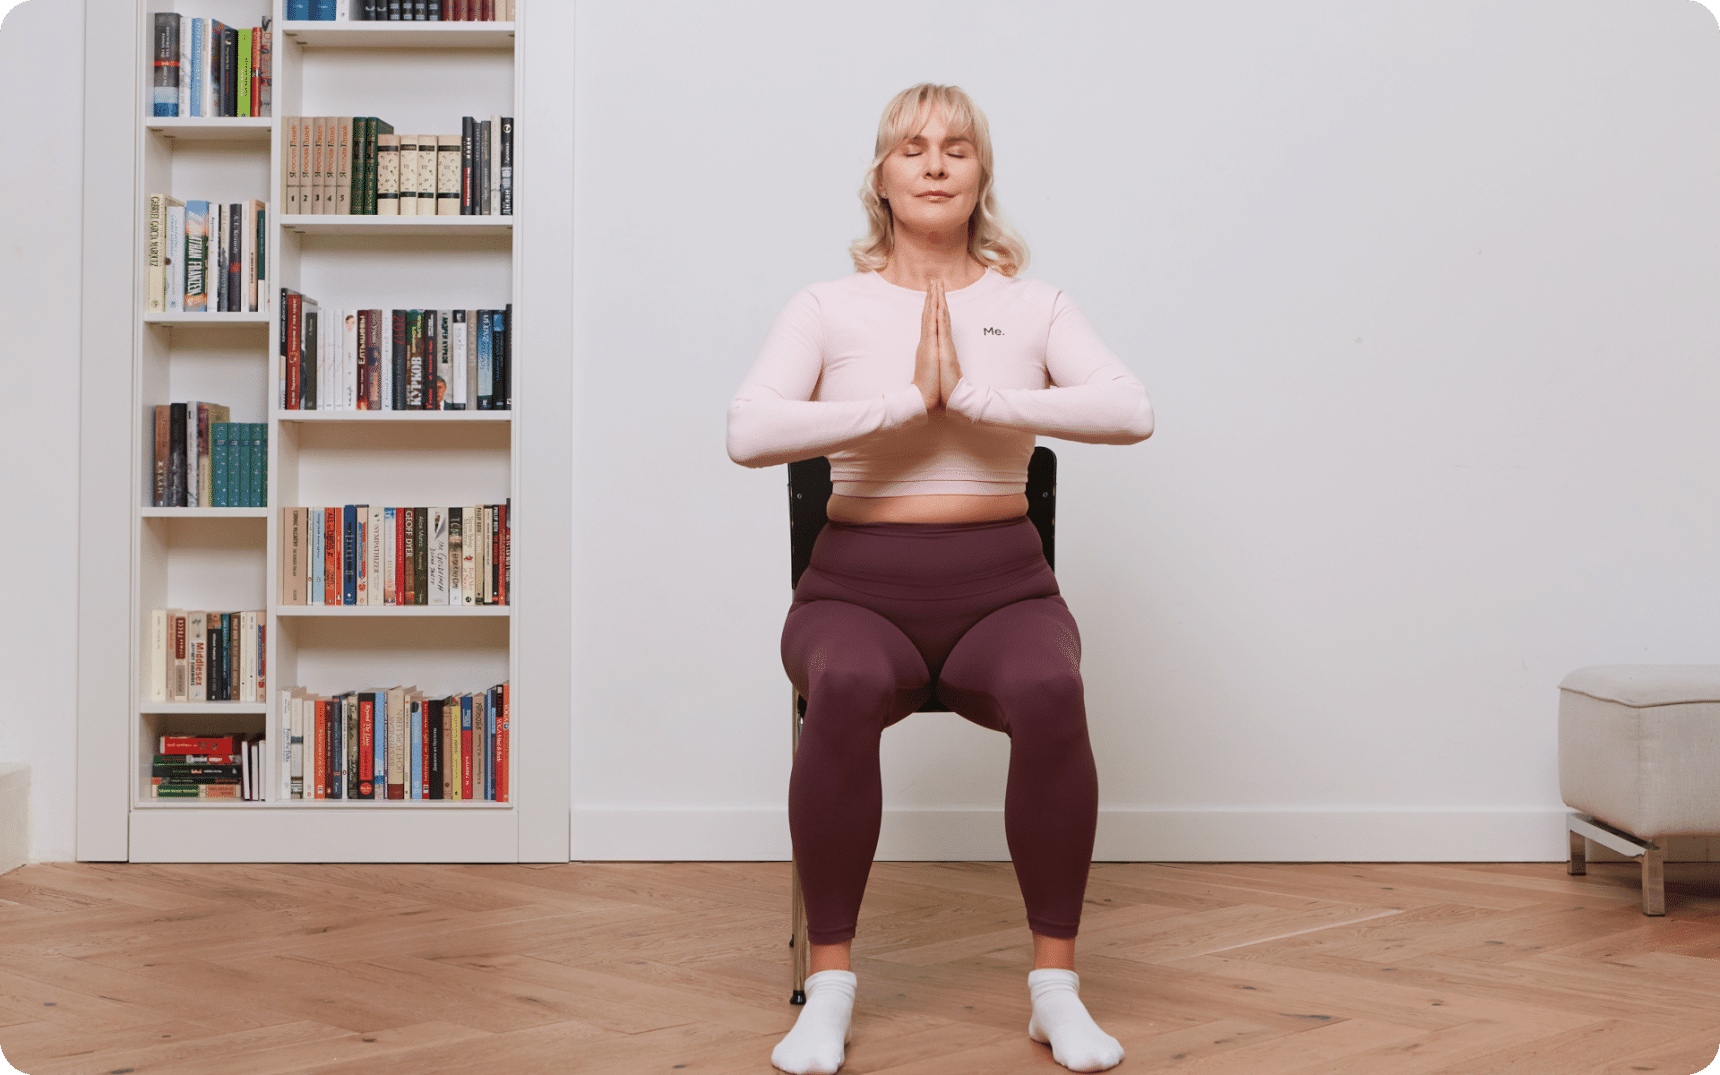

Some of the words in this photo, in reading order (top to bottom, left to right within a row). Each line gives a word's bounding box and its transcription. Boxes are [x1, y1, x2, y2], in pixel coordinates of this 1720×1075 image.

[150, 196, 160, 219] GABRIEL
[503, 189, 511, 215] Дилан
[188, 261, 202, 296] FRANZEN
[393, 315, 405, 345] 2017
[983, 327, 1005, 336] Me.
[411, 357, 422, 405] КУРКОВ
[196, 643, 204, 686] Middlesex
